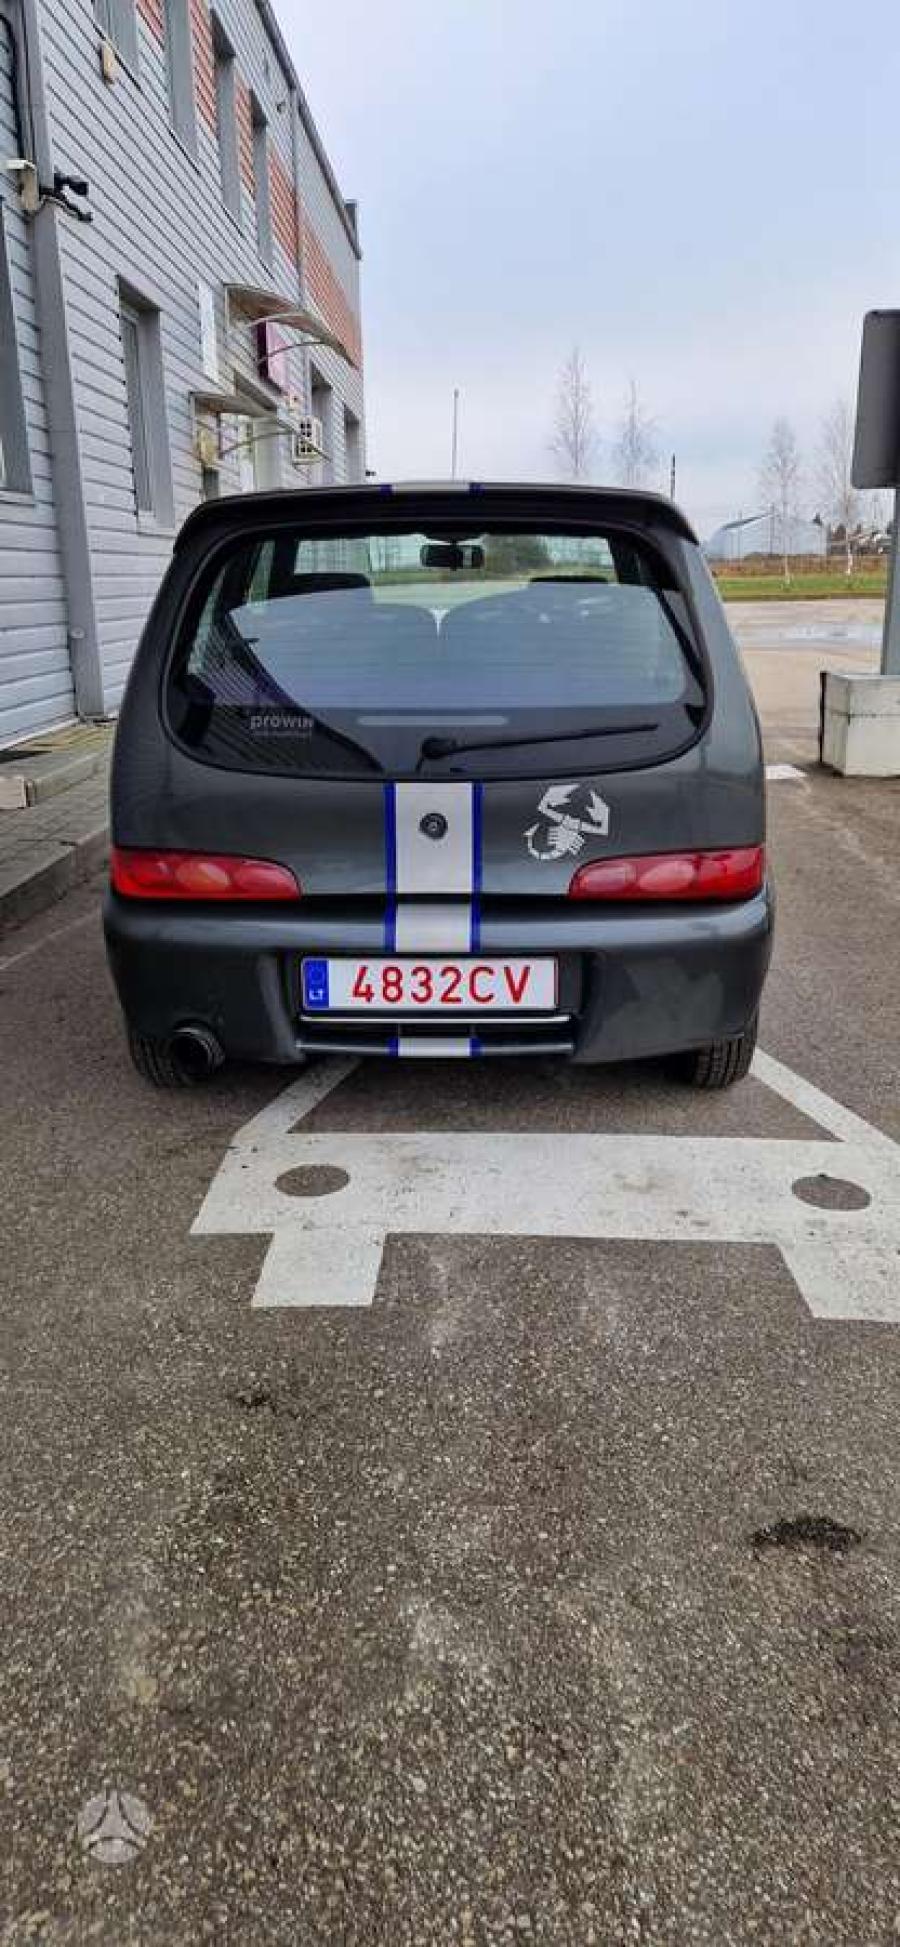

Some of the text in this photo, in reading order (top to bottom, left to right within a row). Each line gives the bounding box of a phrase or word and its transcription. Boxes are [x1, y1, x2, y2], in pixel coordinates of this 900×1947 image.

[250, 715, 314, 730] prowin
[351, 965, 531, 1004] 4832CV
[309, 989, 325, 1001] LT
